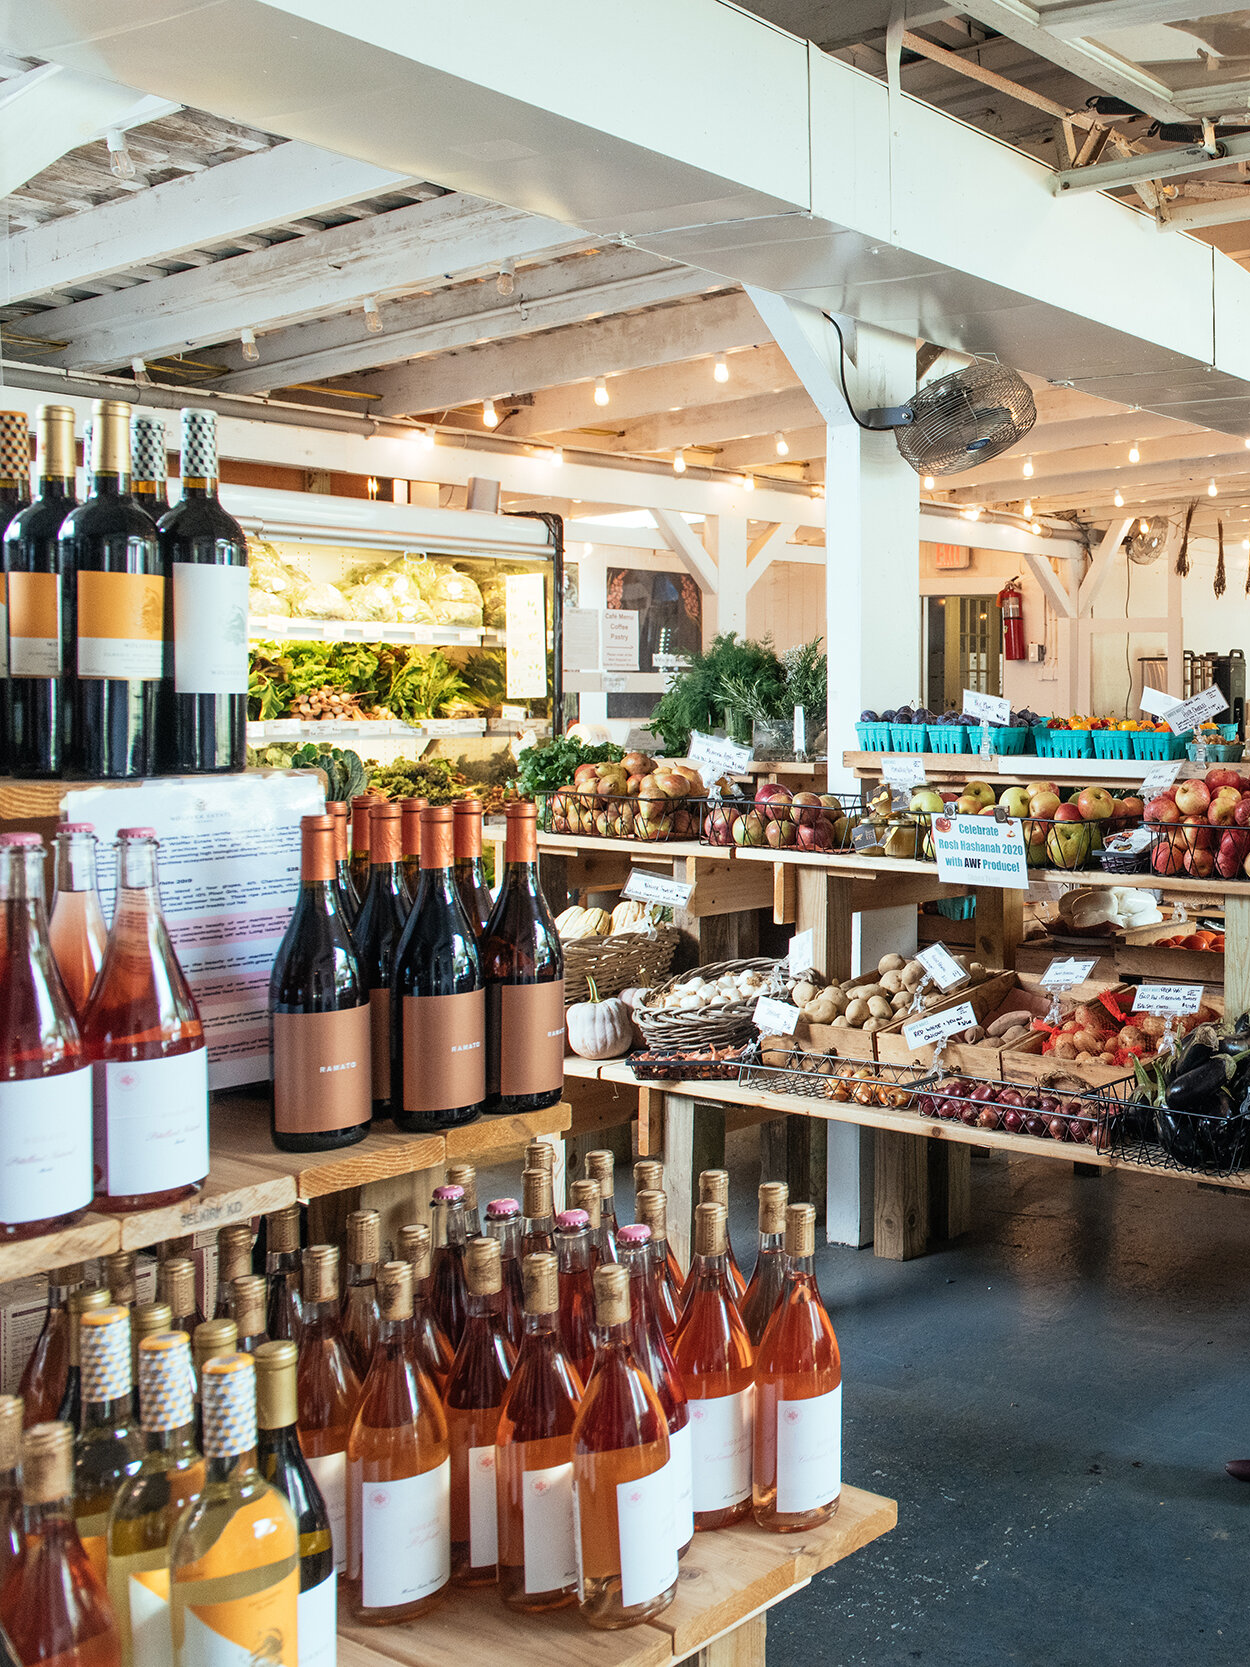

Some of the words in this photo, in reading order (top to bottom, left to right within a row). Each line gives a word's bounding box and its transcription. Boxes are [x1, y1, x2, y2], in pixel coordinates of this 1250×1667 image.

[610, 623, 629, 631] Coffee
[610, 633, 629, 641] Pastry
[958, 823, 999, 836] Celebrate
[938, 839, 959, 850] Rosh
[960, 841, 1000, 853] Hashanah
[1002, 844, 1023, 856] 2020
[945, 857, 963, 868] with
[964, 858, 981, 869] AWF
[983, 858, 1020, 873] Produce!
[547, 1026, 566, 1037] RAMAT
[451, 1041, 481, 1053] RAMATO
[319, 1061, 357, 1073] RAMATO
